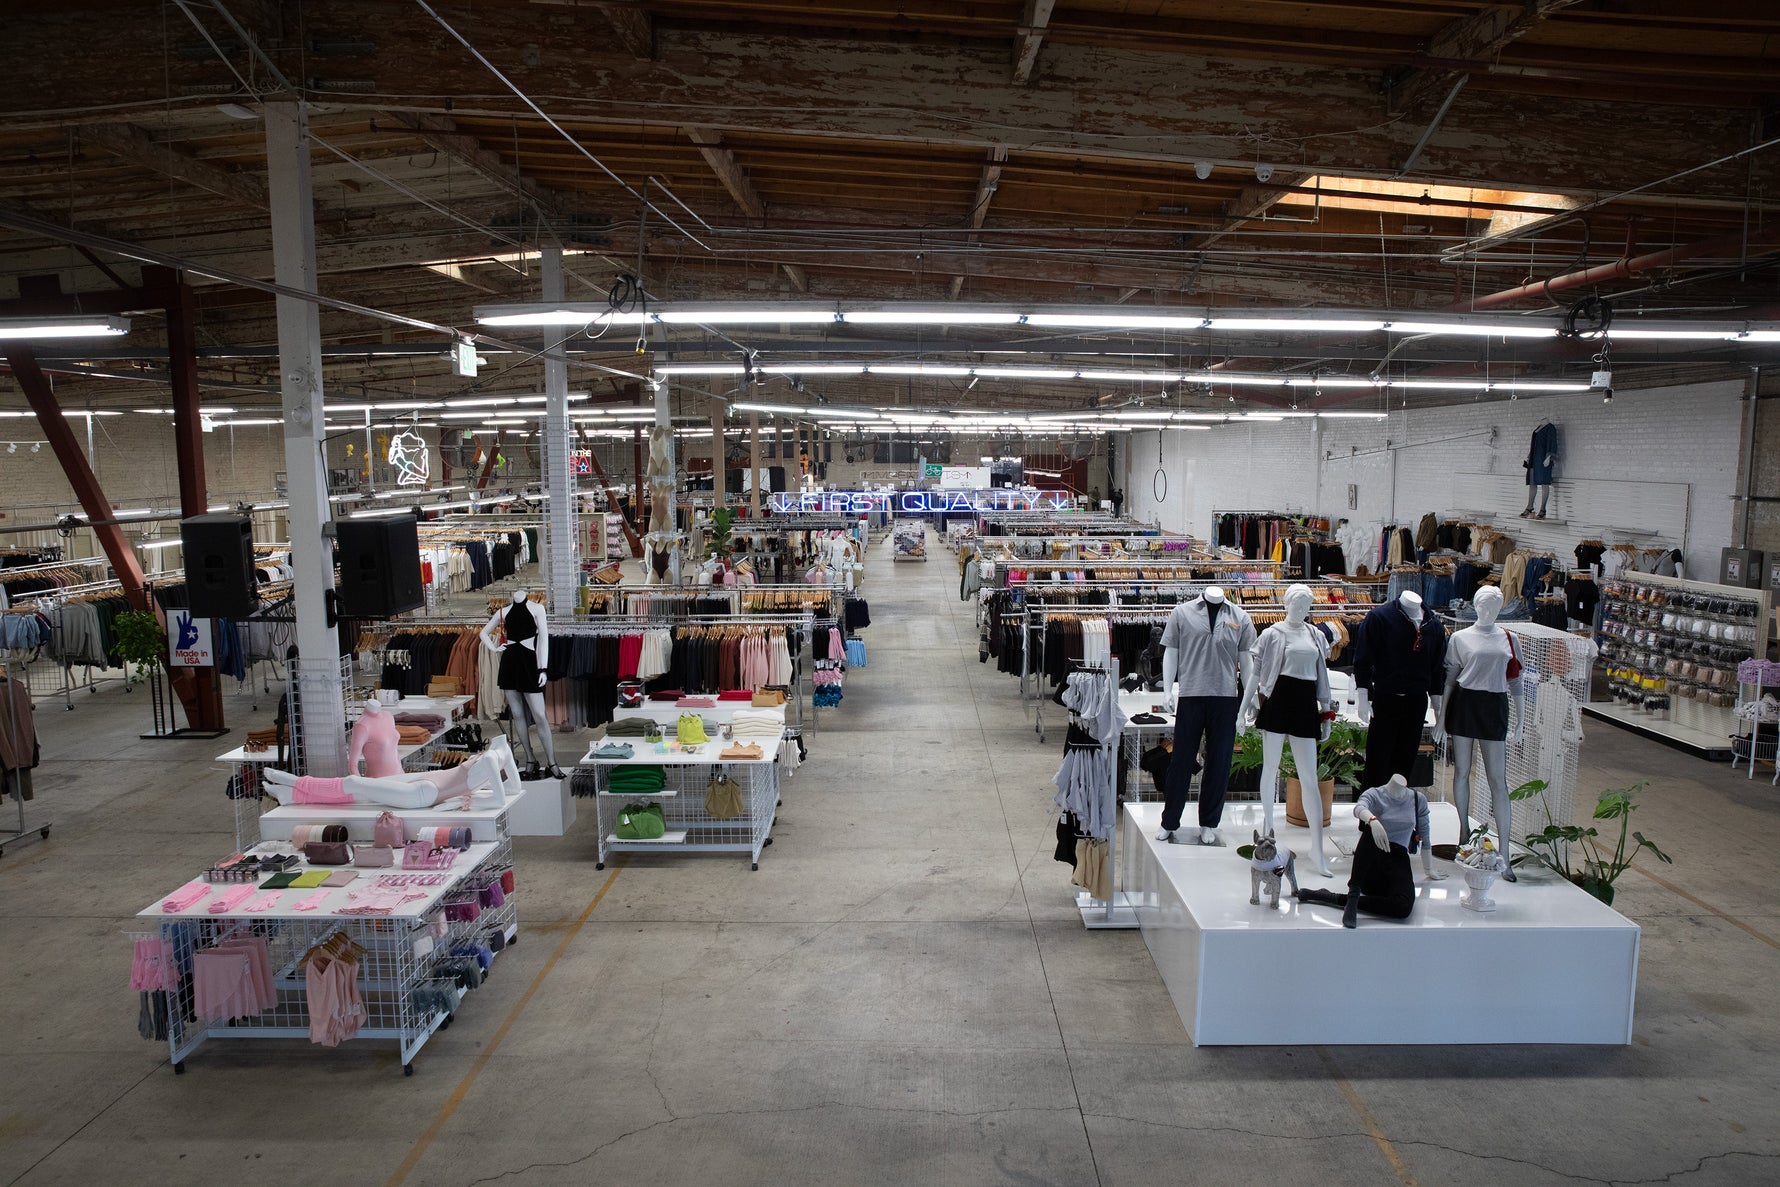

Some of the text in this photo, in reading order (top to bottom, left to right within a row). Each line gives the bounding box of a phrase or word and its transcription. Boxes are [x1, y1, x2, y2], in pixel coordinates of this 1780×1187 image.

[801, 491, 1042, 512] FIRST QUALITY
[175, 650, 208, 658] Made in
[184, 657, 200, 665] USA
